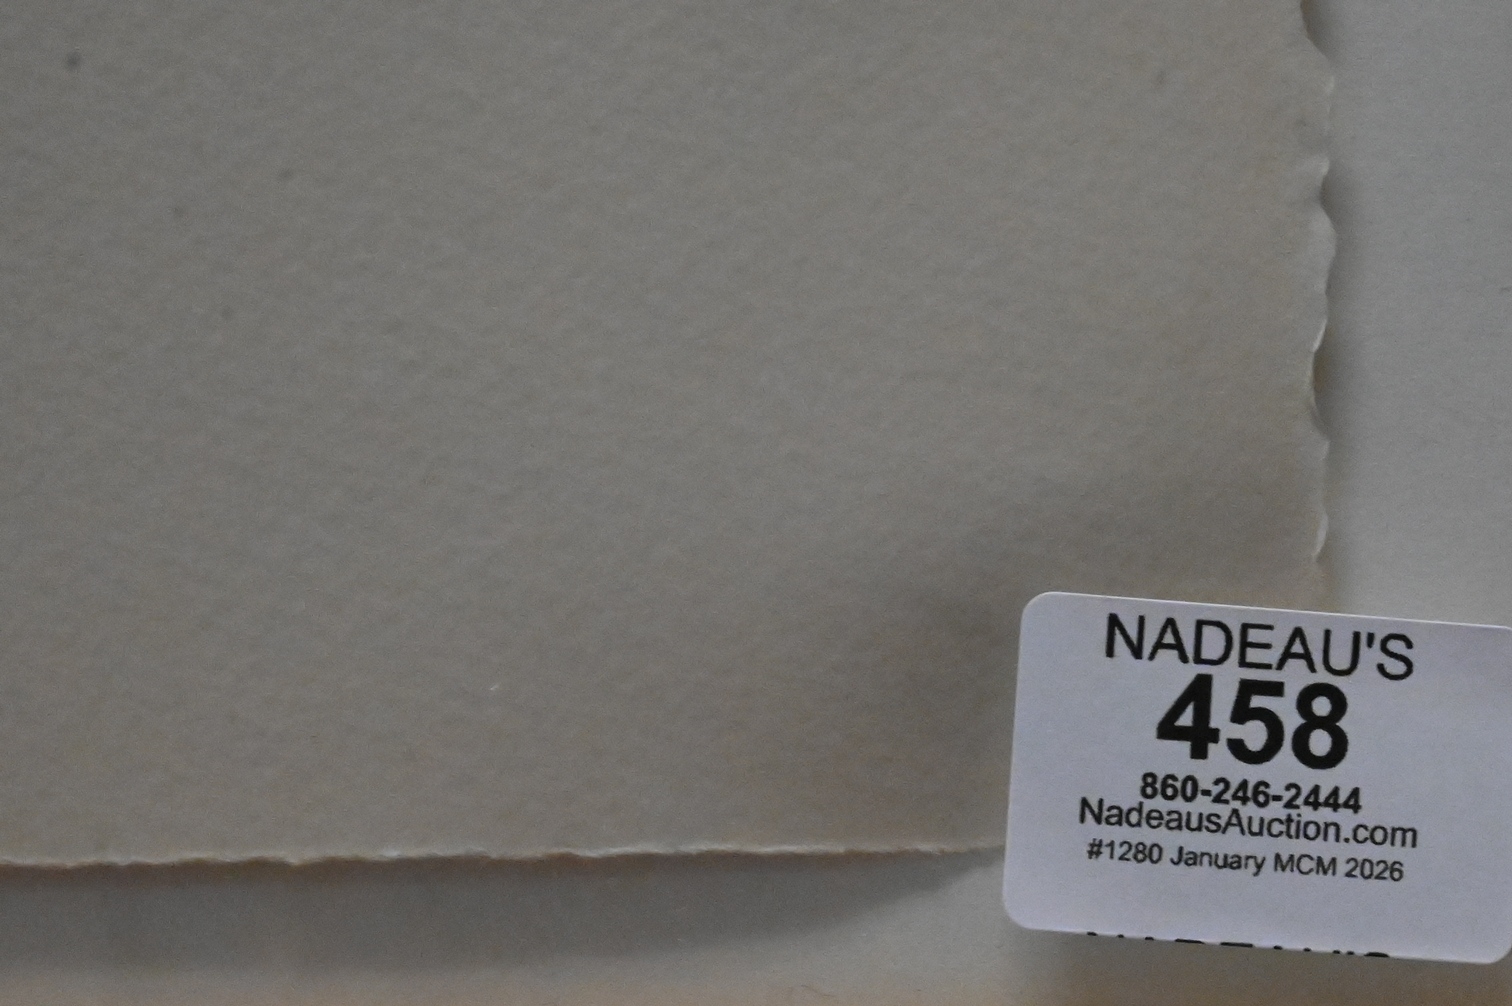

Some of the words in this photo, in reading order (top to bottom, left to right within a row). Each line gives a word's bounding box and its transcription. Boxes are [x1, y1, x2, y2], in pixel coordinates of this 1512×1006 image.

[1104, 612, 1415, 682] NADEAU'S
[1155, 672, 1350, 770] 458
[1139, 771, 1363, 815] 860-246-2444
[1078, 796, 1418, 849] NadeausAuction.com
[1086, 837, 1164, 865] #1280
[1169, 845, 1266, 878] January
[1273, 853, 1338, 878] MCM
[1344, 857, 1405, 883] 2026
